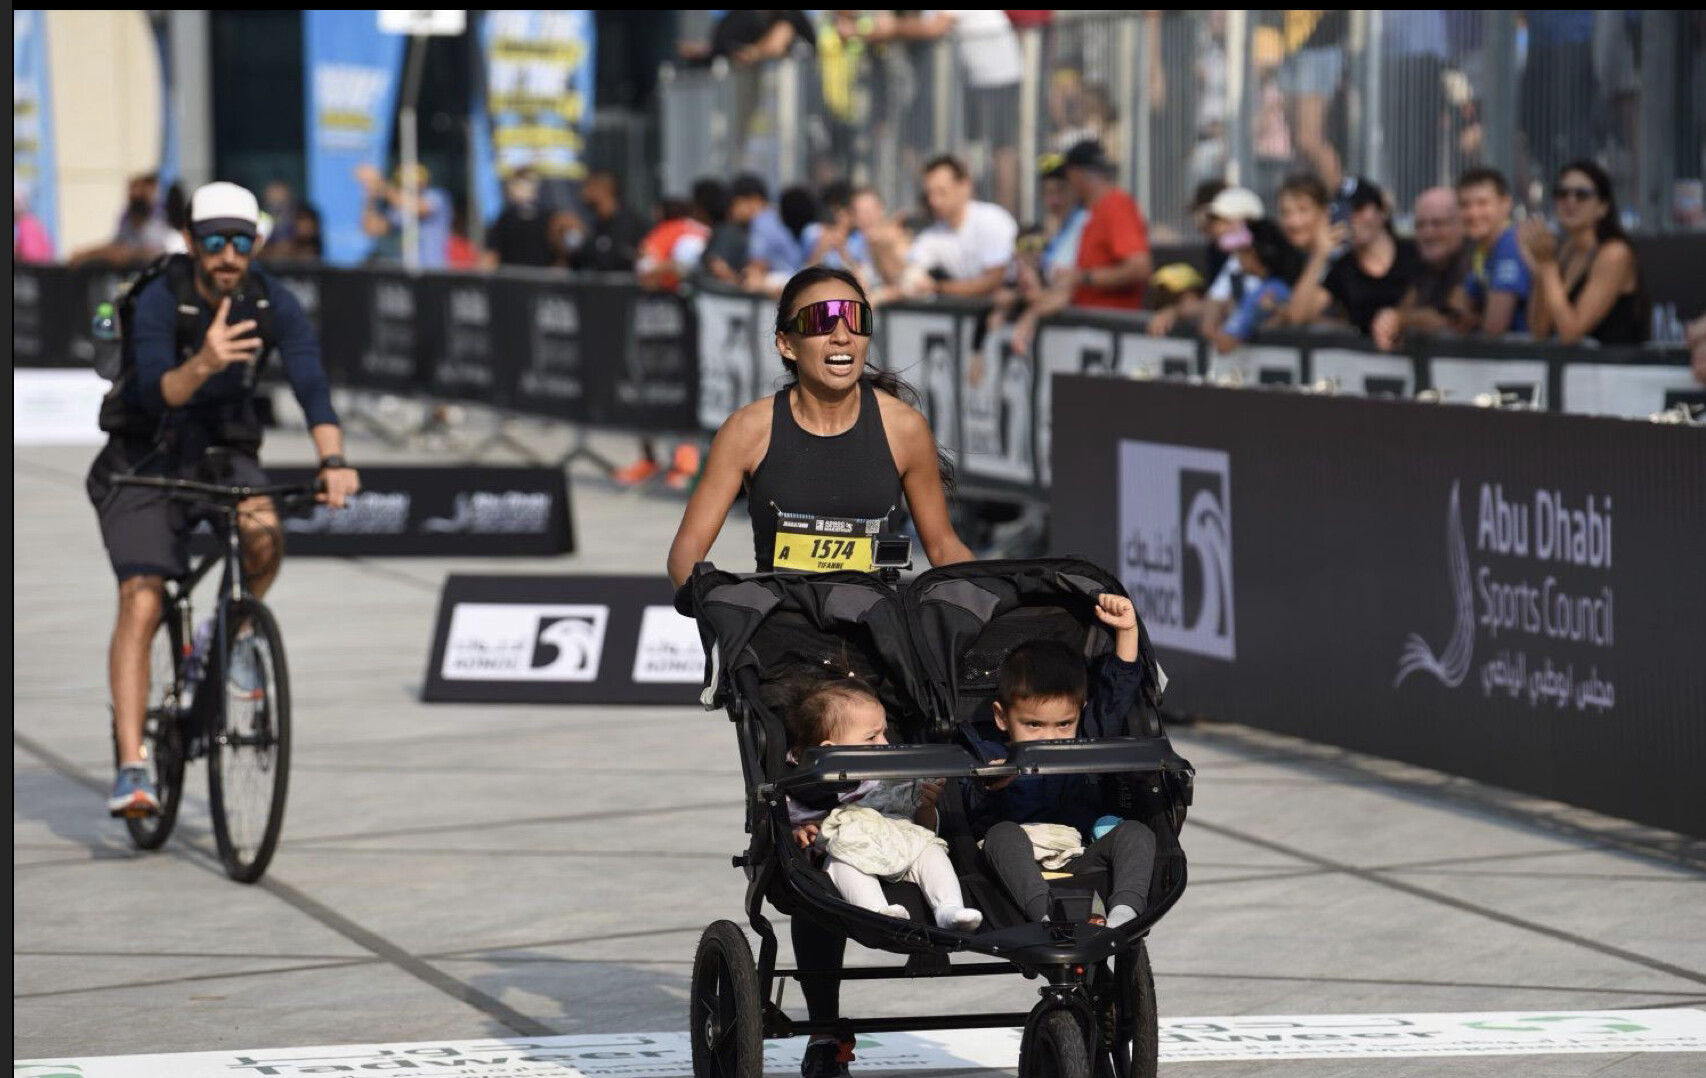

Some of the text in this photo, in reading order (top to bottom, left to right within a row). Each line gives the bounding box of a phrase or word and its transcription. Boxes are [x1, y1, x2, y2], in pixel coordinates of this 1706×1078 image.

[1478, 482, 1612, 568] Abu Dhabi
[779, 546, 790, 560] A
[811, 539, 856, 559] 1574
[1478, 566, 1614, 647] Sports Council
[229, 1050, 675, 1075] Tadweer
